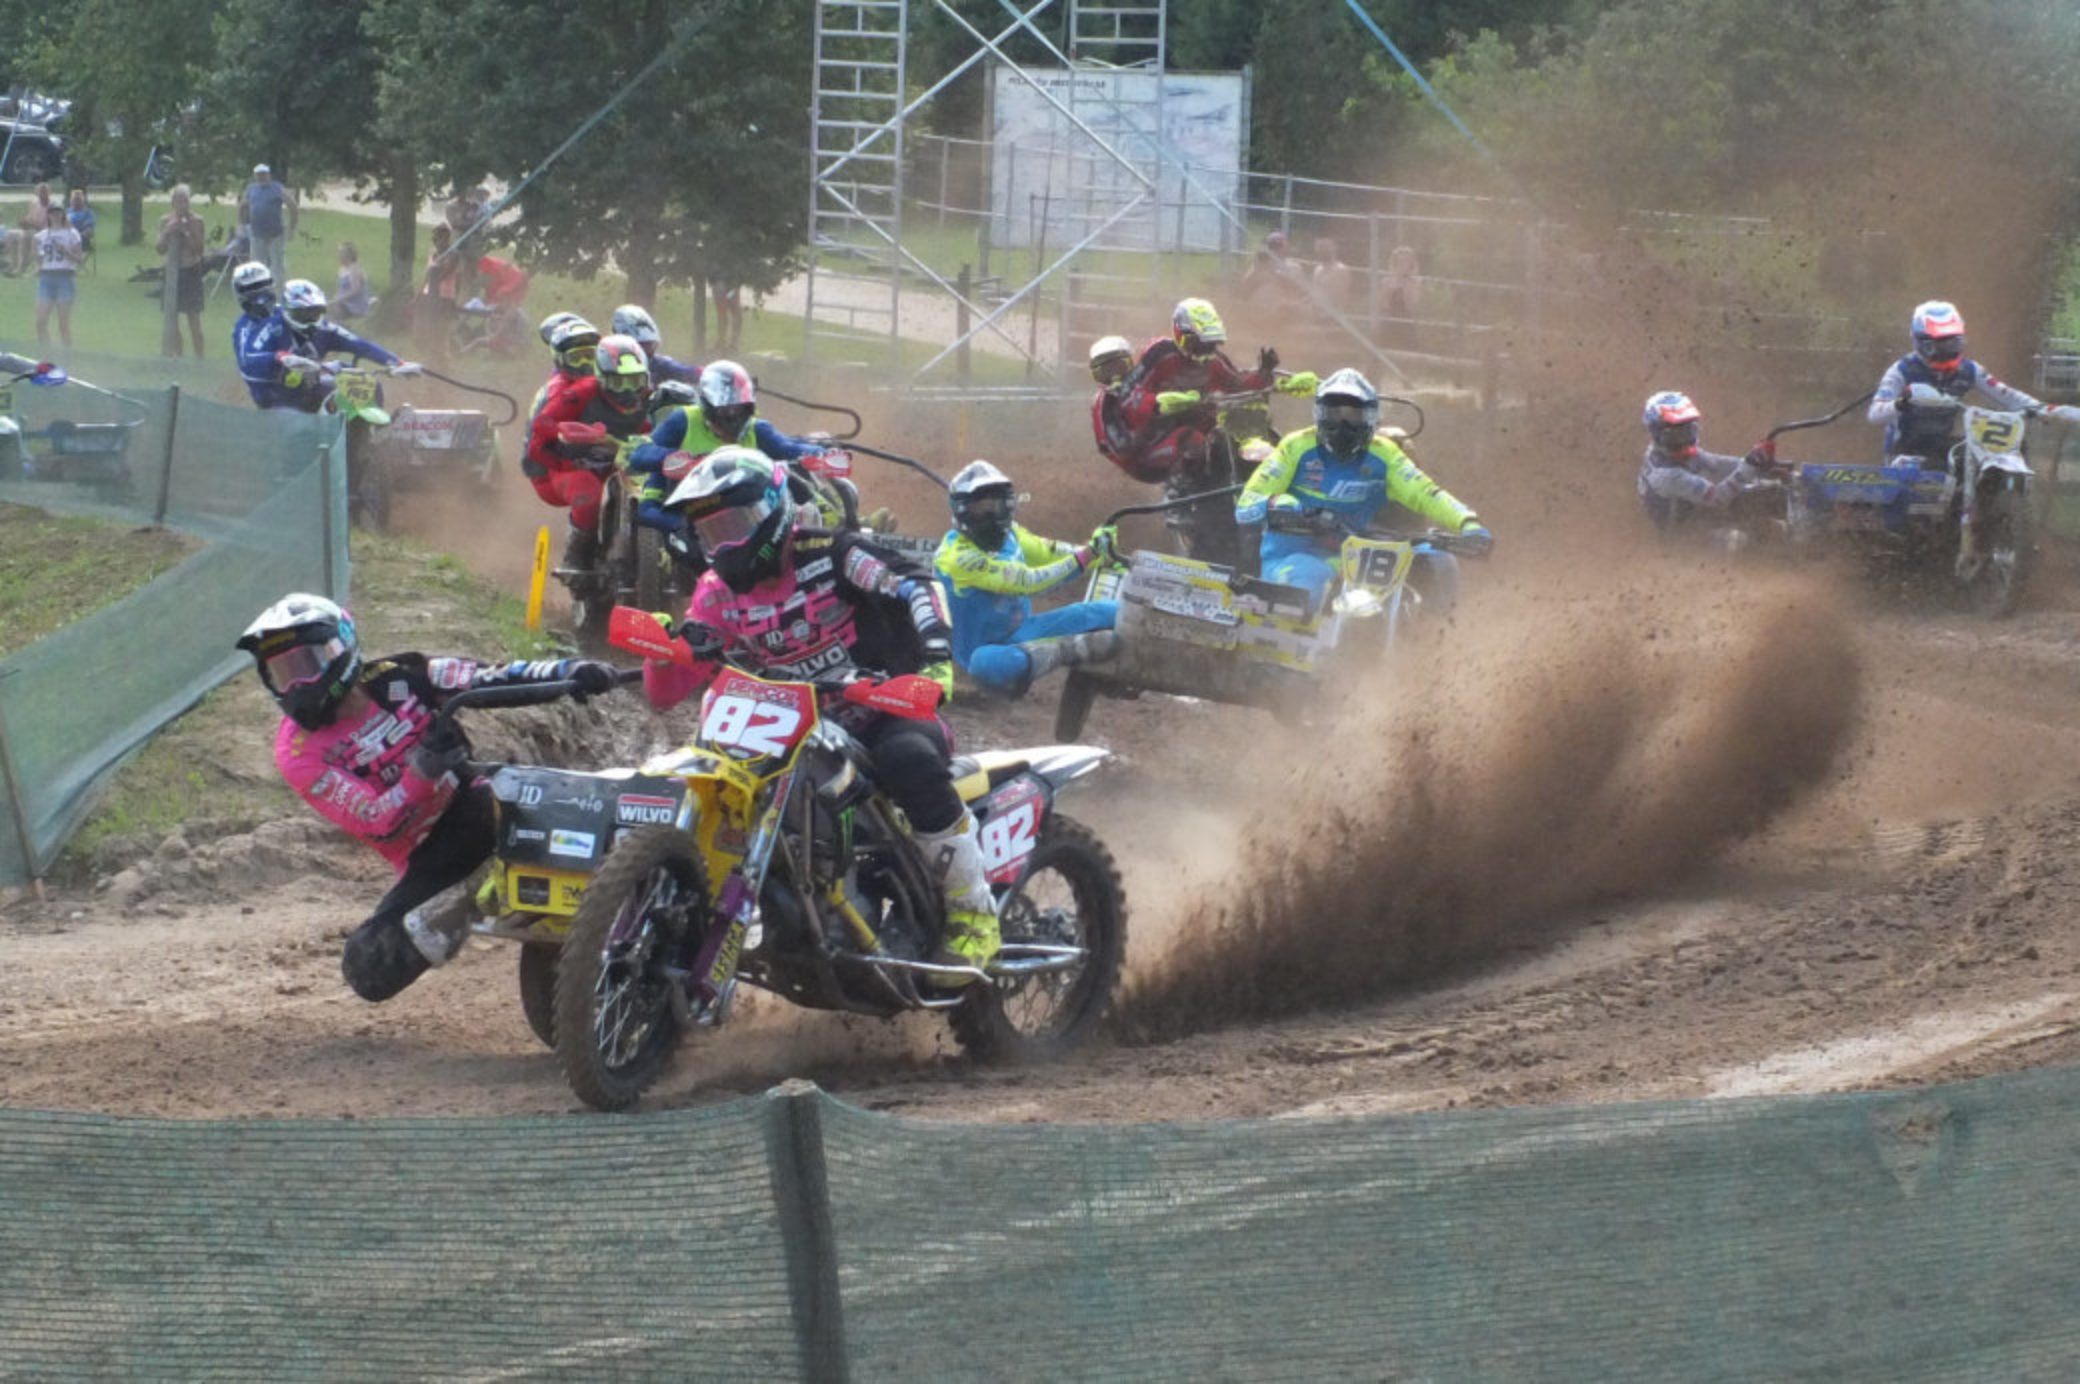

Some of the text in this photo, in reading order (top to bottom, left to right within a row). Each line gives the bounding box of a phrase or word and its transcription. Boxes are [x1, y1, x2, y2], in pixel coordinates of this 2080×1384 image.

[1981, 420, 2013, 447] 2
[1353, 547, 1399, 586] 18
[701, 694, 802, 759] 82
[619, 806, 673, 823] WILVO
[980, 803, 1037, 872] 82
